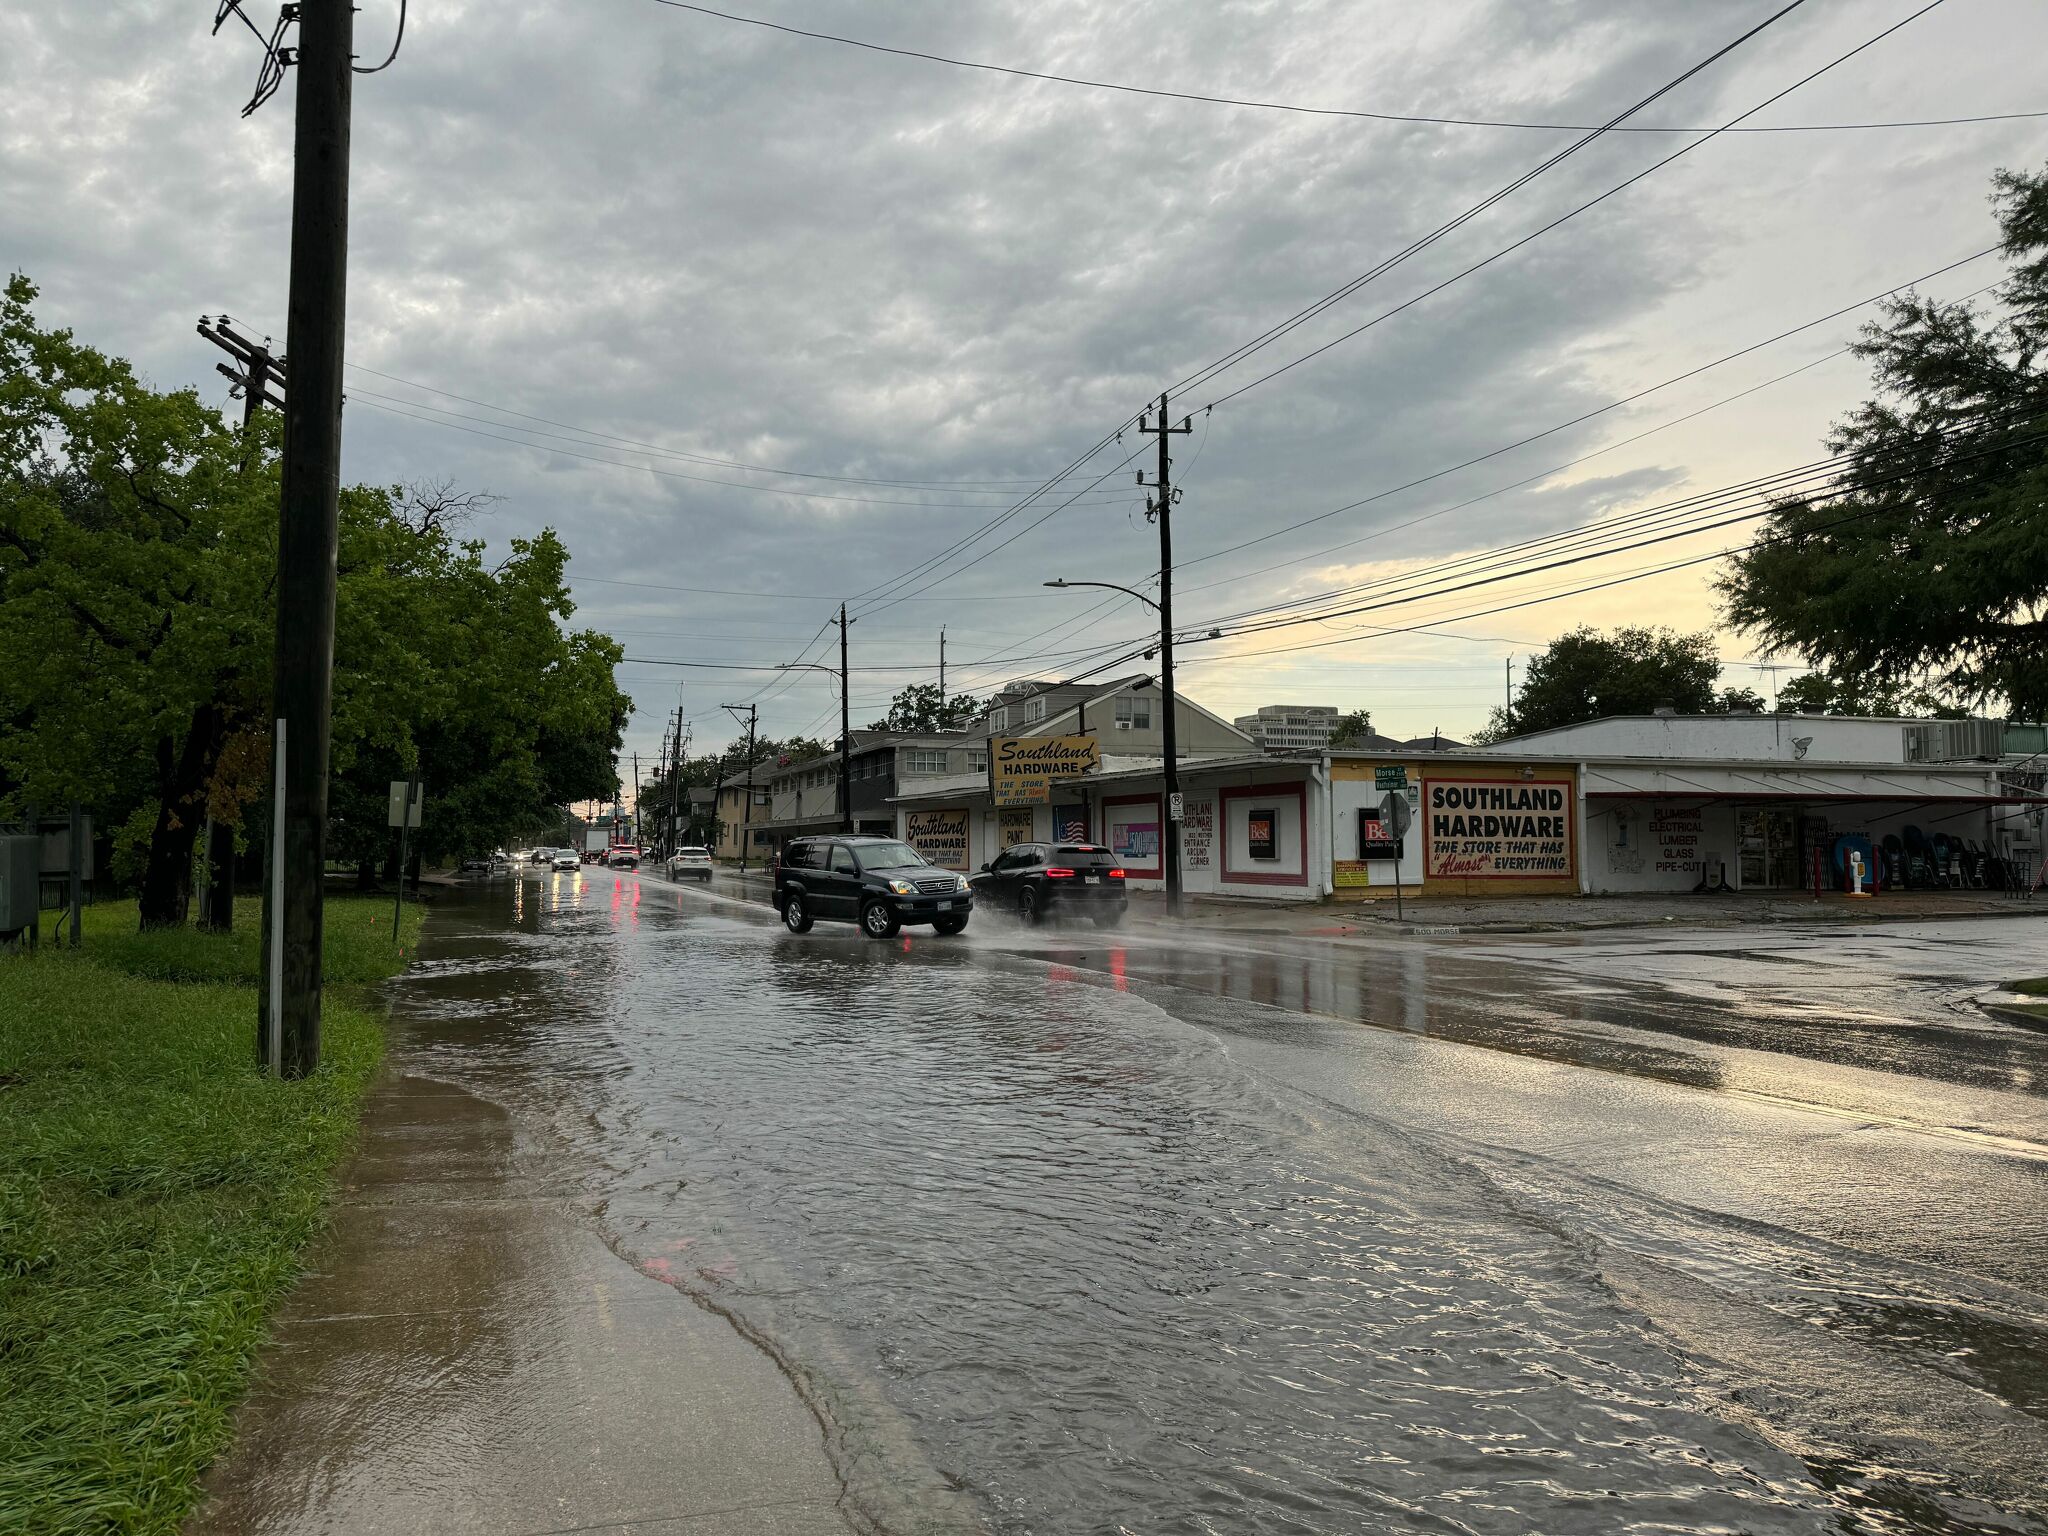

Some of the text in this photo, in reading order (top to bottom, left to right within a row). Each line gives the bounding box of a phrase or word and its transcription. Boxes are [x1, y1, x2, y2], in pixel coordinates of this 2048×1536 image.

[998, 740, 1095, 761] Southland
[1004, 762, 1079, 775] HARDWARE
[1376, 769, 1395, 777] Morse
[1000, 780, 1044, 789] THE STORE
[1014, 789, 1026, 797] HAS
[1004, 796, 1044, 805] EVERYTHING
[1432, 787, 1563, 811] SOUTHLAND
[1000, 812, 1031, 826] HARDWARE
[1654, 808, 1701, 819] PLUMBING
[908, 813, 967, 841] Southland
[1433, 815, 1564, 838] HARDWARE
[1649, 822, 1704, 832] ELECTRICAL
[1007, 830, 1024, 843] PAINT
[1659, 832, 1698, 845] LUMBER
[917, 838, 967, 849] HARDWARE
[1184, 838, 1210, 847] ENTRANCE
[1433, 840, 1564, 854] THE STORE THAT HAS
[1186, 847, 1207, 856] AROUND
[1663, 848, 1694, 859] GLASS
[1189, 857, 1210, 866] CORNER
[1494, 856, 1566, 870] EVERYTHING
[1656, 861, 1701, 872] PIPE-CUT
[1434, 928, 1459, 936] MORSE
